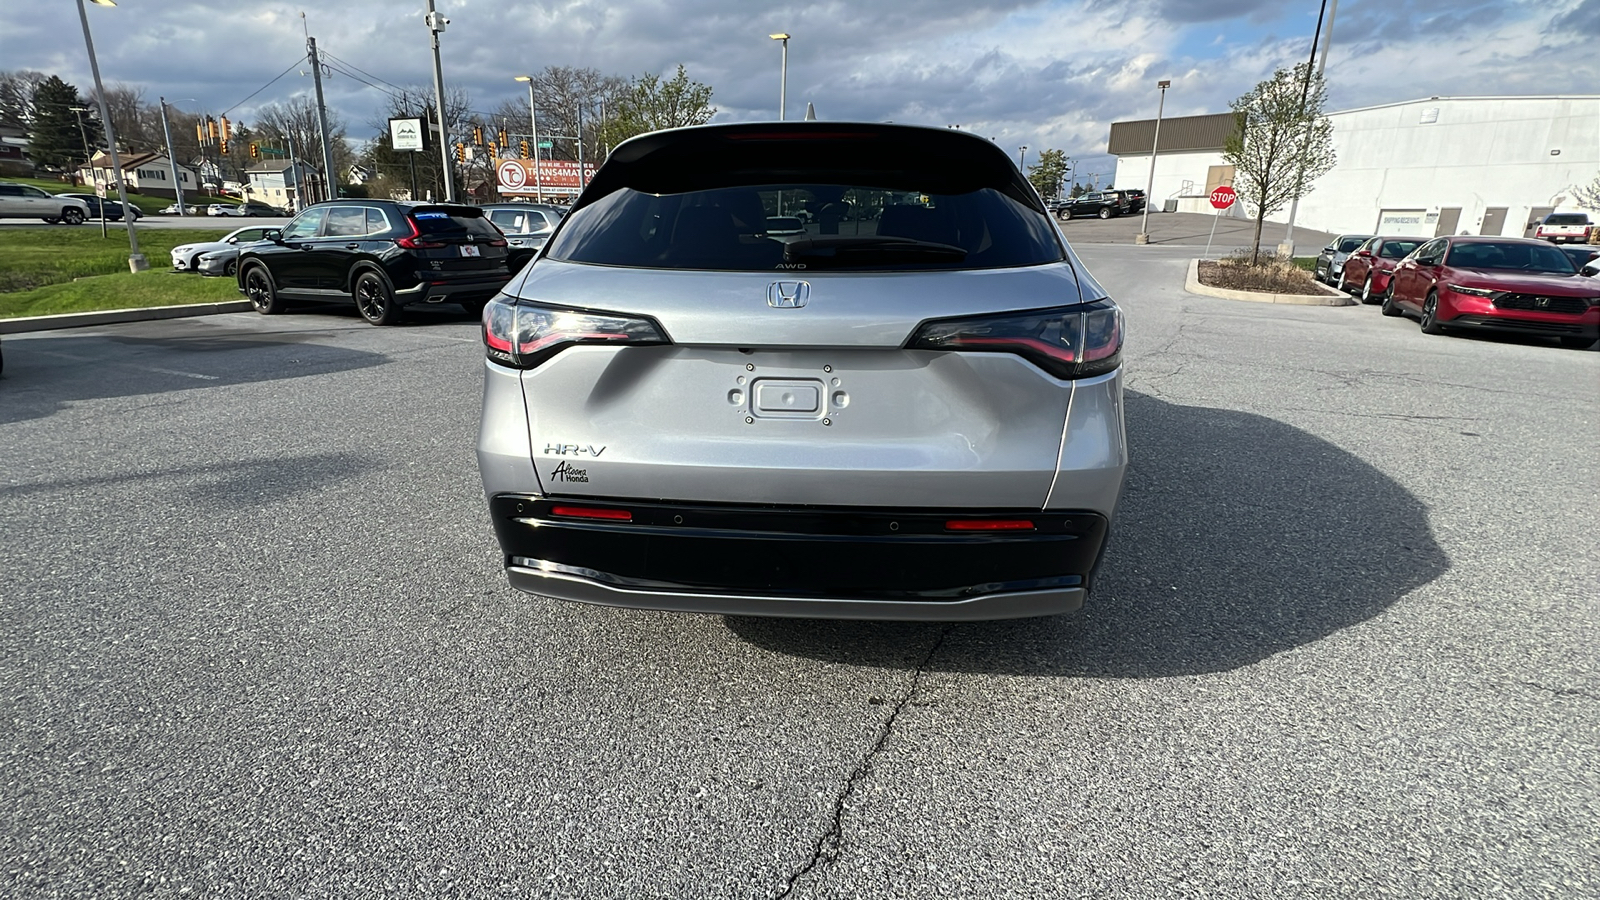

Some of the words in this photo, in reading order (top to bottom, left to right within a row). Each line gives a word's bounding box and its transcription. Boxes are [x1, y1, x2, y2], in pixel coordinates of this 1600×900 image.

[1211, 192, 1235, 203] STOP
[544, 443, 607, 457] HR-V
[566, 475, 589, 483] Honda
